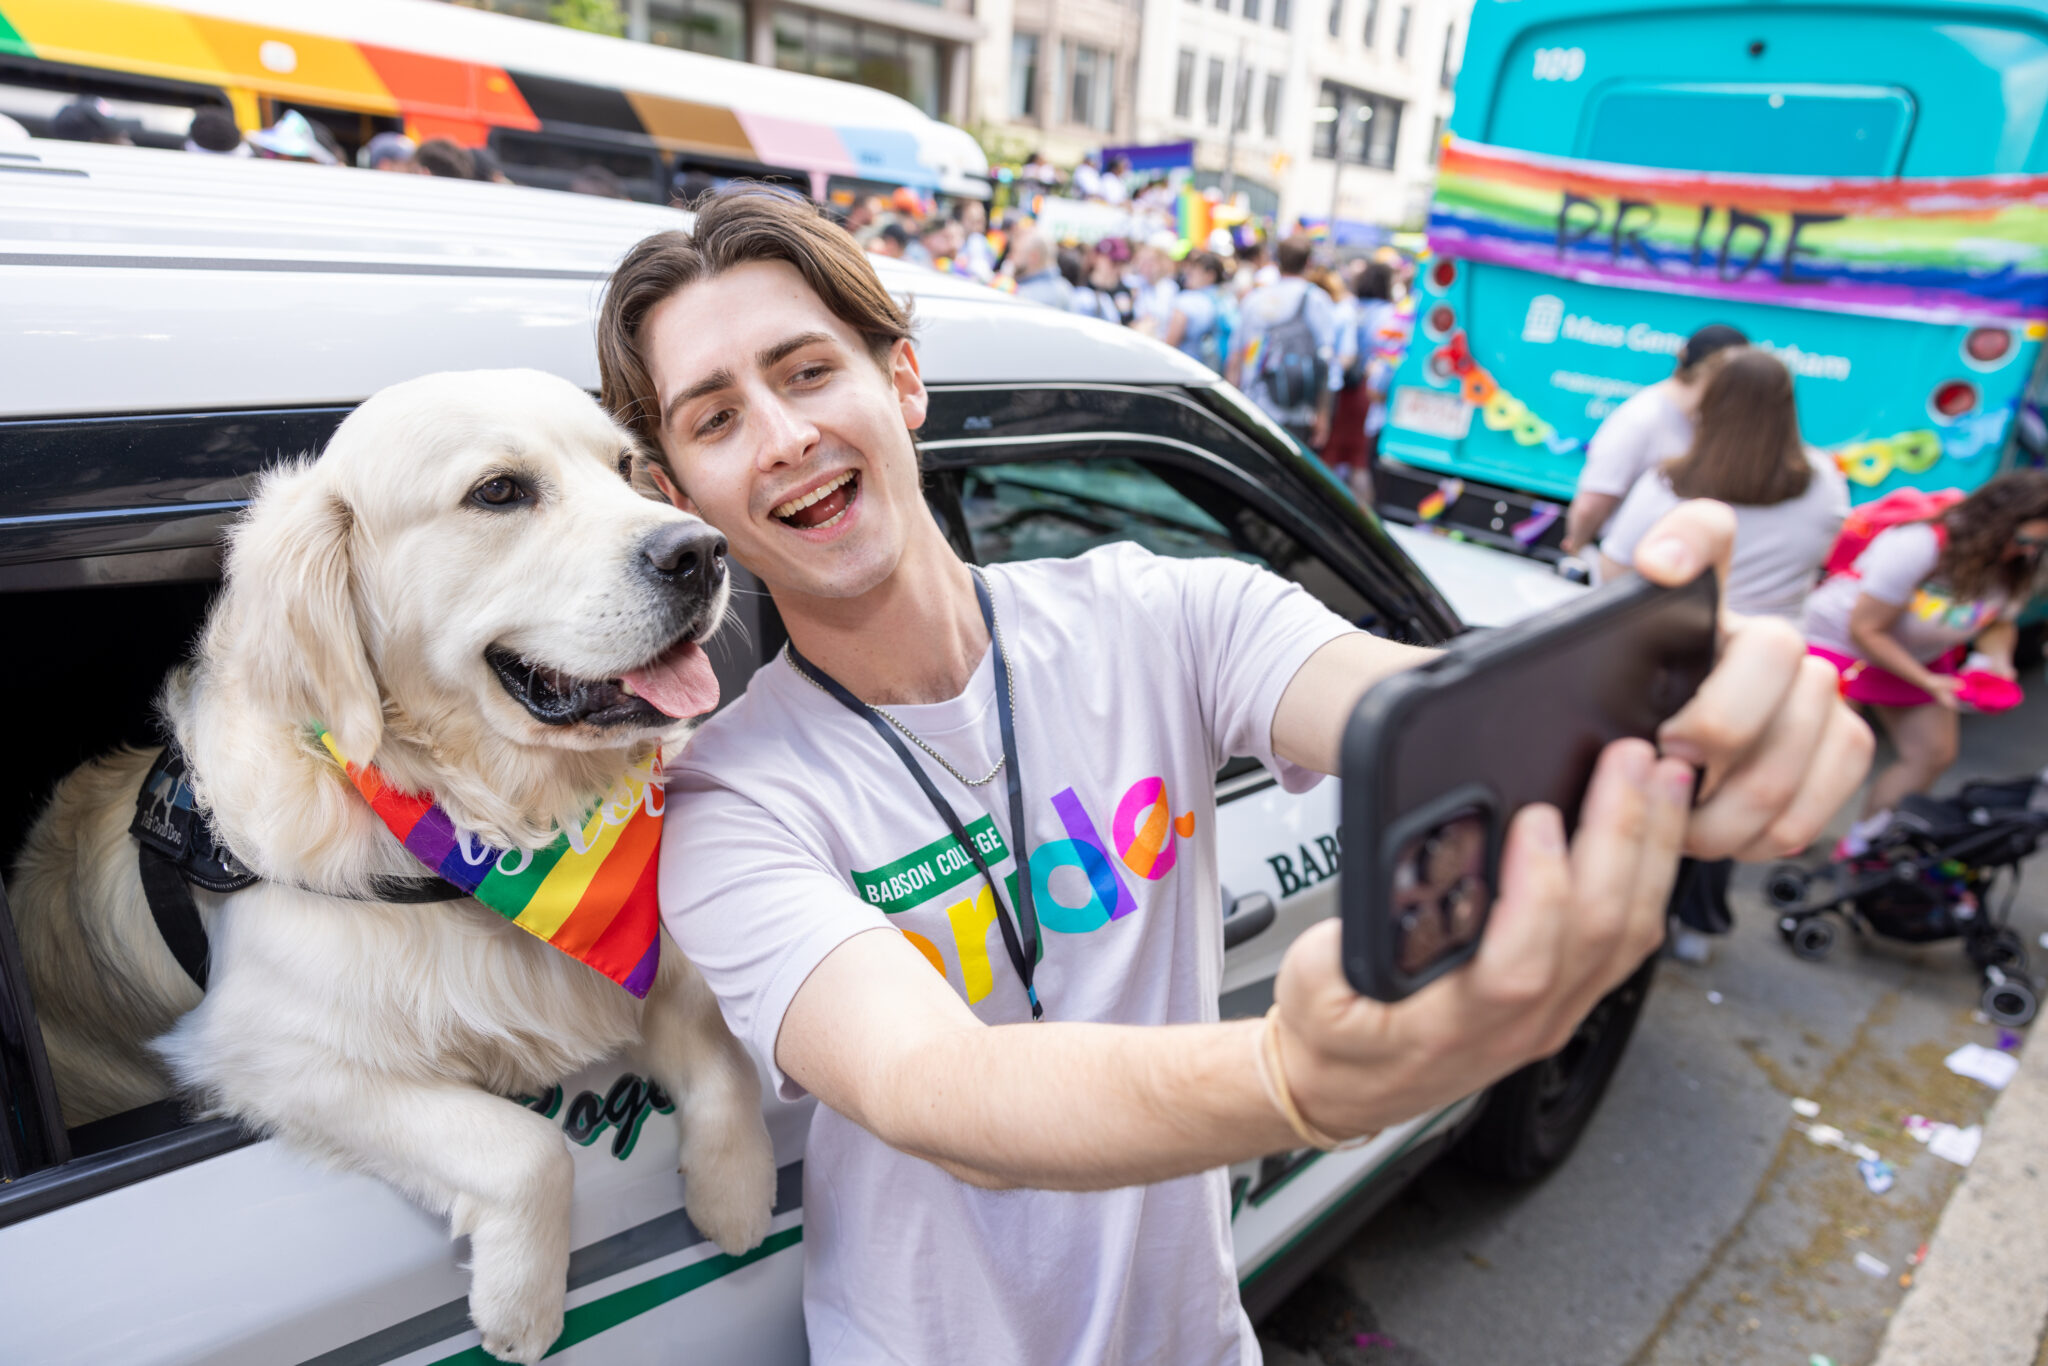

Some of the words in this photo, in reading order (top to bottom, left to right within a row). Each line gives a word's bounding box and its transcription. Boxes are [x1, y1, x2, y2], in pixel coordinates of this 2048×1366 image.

[1532, 47, 1586, 82] 109
[1555, 189, 1847, 286] PRIDE
[865, 861, 936, 904] BABSON
[936, 827, 1002, 876] COLLGE
[1265, 824, 1343, 899] BAB
